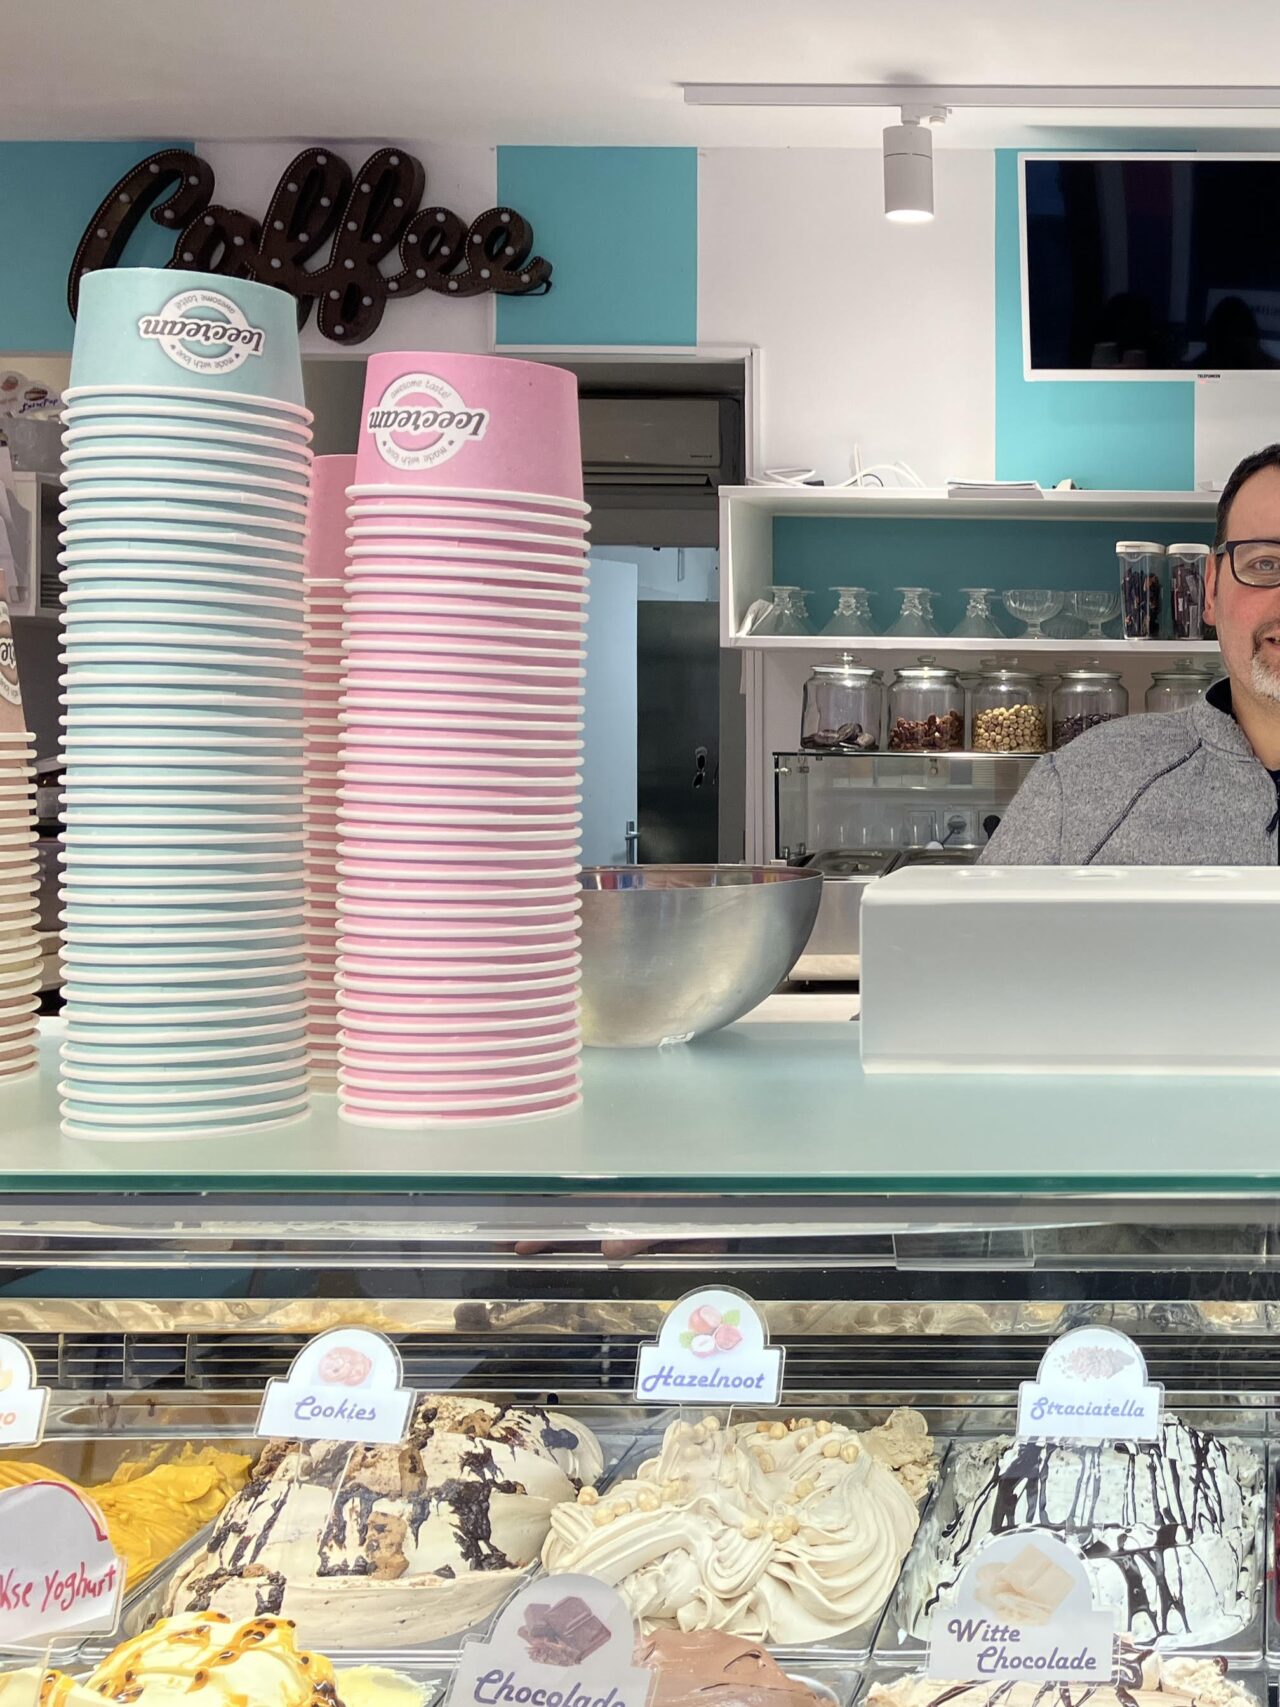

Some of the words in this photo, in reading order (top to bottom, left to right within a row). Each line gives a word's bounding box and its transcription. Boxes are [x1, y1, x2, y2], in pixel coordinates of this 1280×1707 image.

[68, 148, 552, 345] Coffee
[642, 1365, 765, 1393] Hazelnoot
[294, 1395, 377, 1422] Cookies
[1030, 1396, 1145, 1421] Straciatella
[41, 1561, 117, 1613] Yoghurt
[947, 1618, 1022, 1645] Witte
[977, 1645, 1098, 1675] Chocolade
